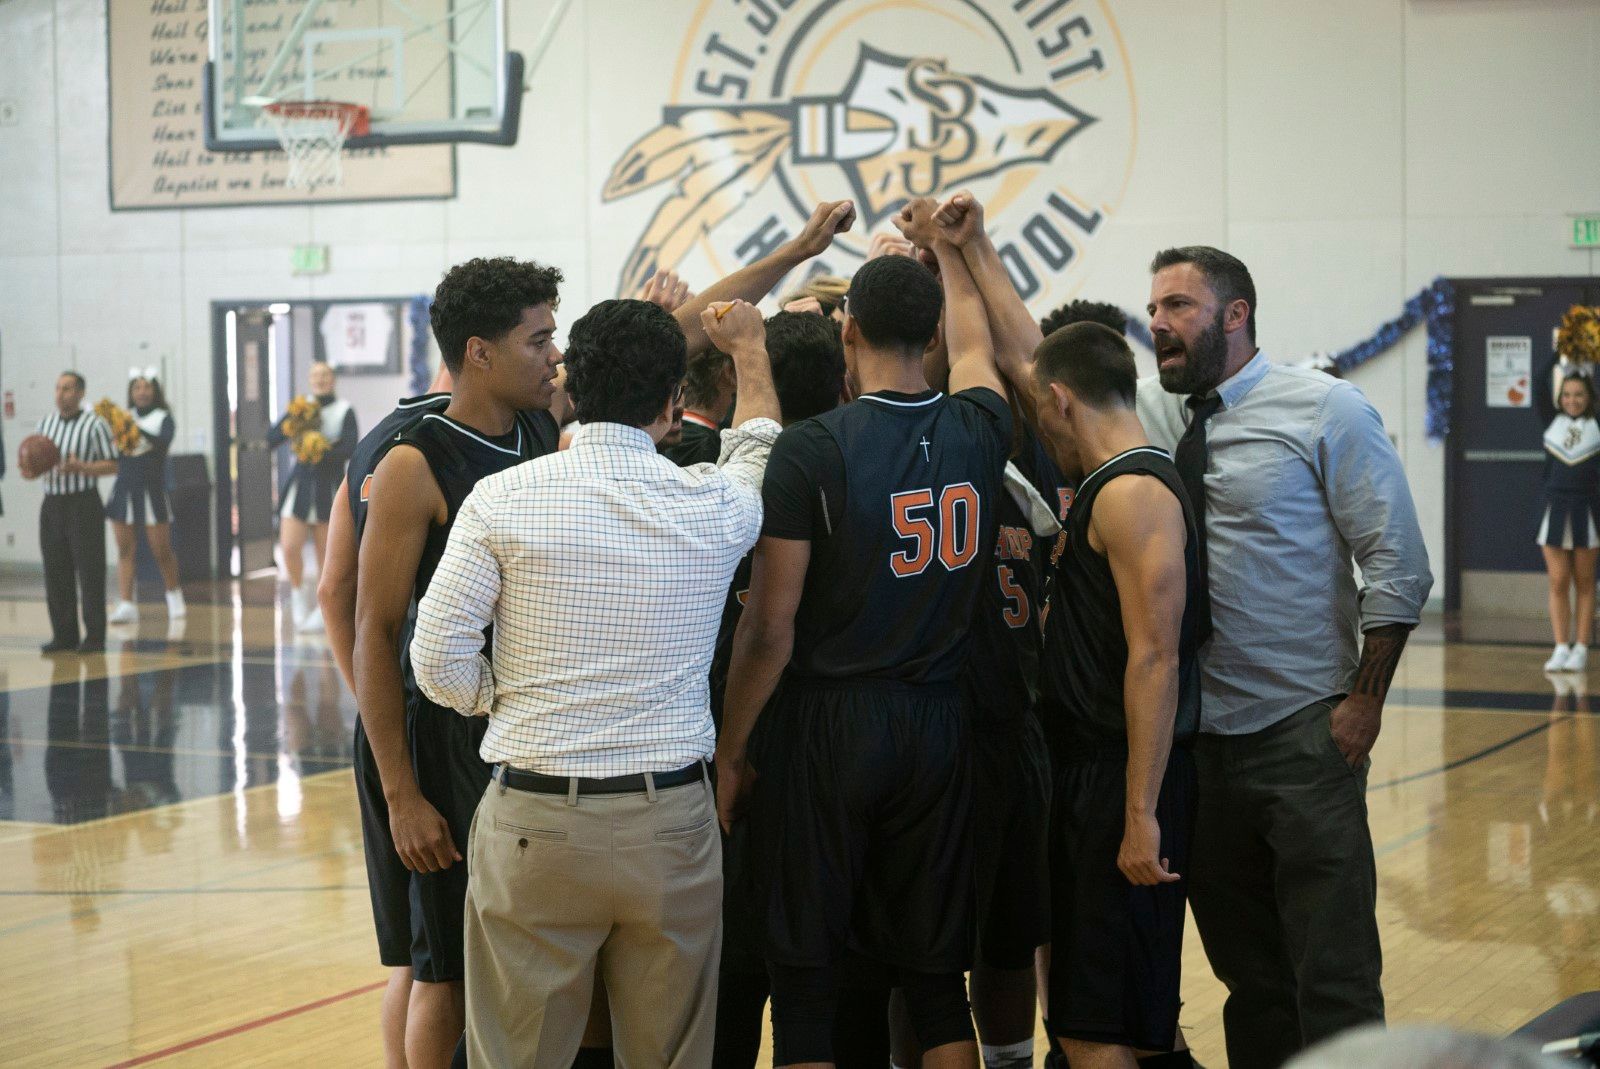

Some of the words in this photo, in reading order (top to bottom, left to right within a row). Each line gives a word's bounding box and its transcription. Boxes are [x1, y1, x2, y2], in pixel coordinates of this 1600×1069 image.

[151, 20, 188, 41] Hail
[152, 149, 190, 168] Hail
[890, 481, 980, 578] 50
